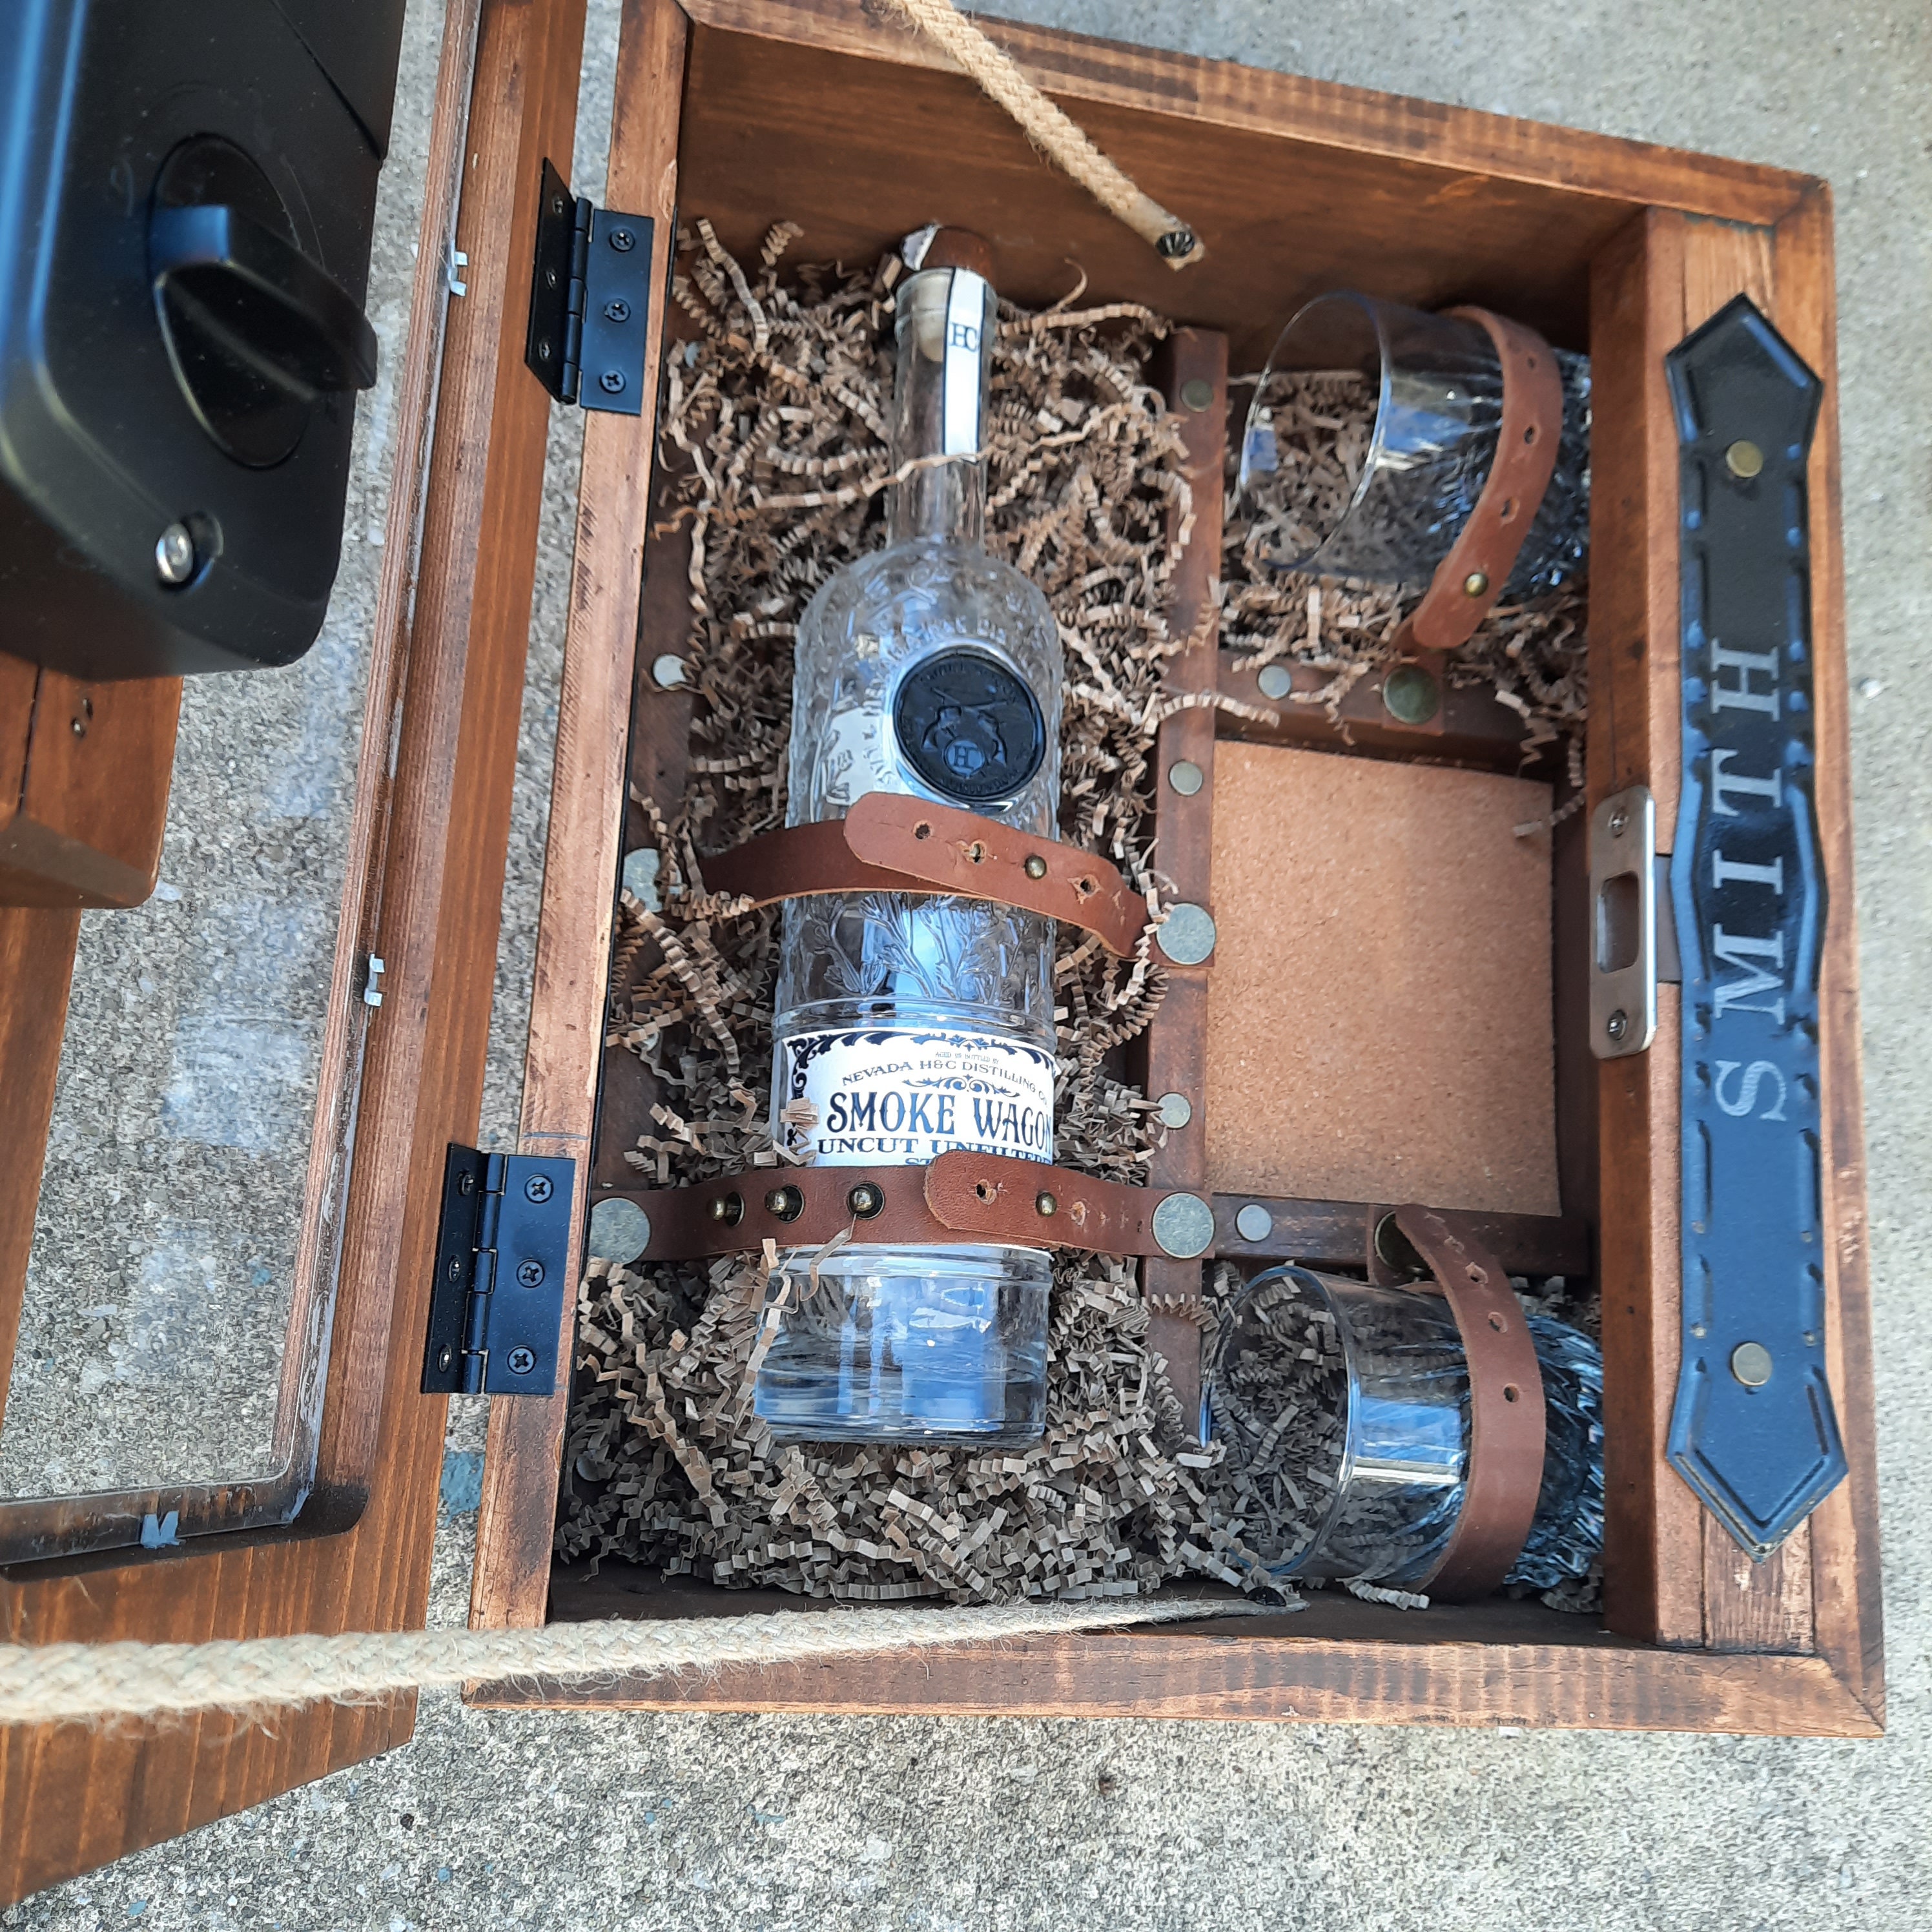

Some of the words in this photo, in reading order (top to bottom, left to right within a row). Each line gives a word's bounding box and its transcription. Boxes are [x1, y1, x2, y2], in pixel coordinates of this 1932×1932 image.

[1710, 638, 1787, 1122] SMITH
[842, 1062, 914, 1086] NEVADA
[920, 1060, 956, 1069] H&C
[962, 1062, 1036, 1093] DISTILLING
[817, 1137, 918, 1155] UNCUT
[827, 1091, 956, 1135] SMOKE
[972, 1098, 1052, 1155] WAGON
